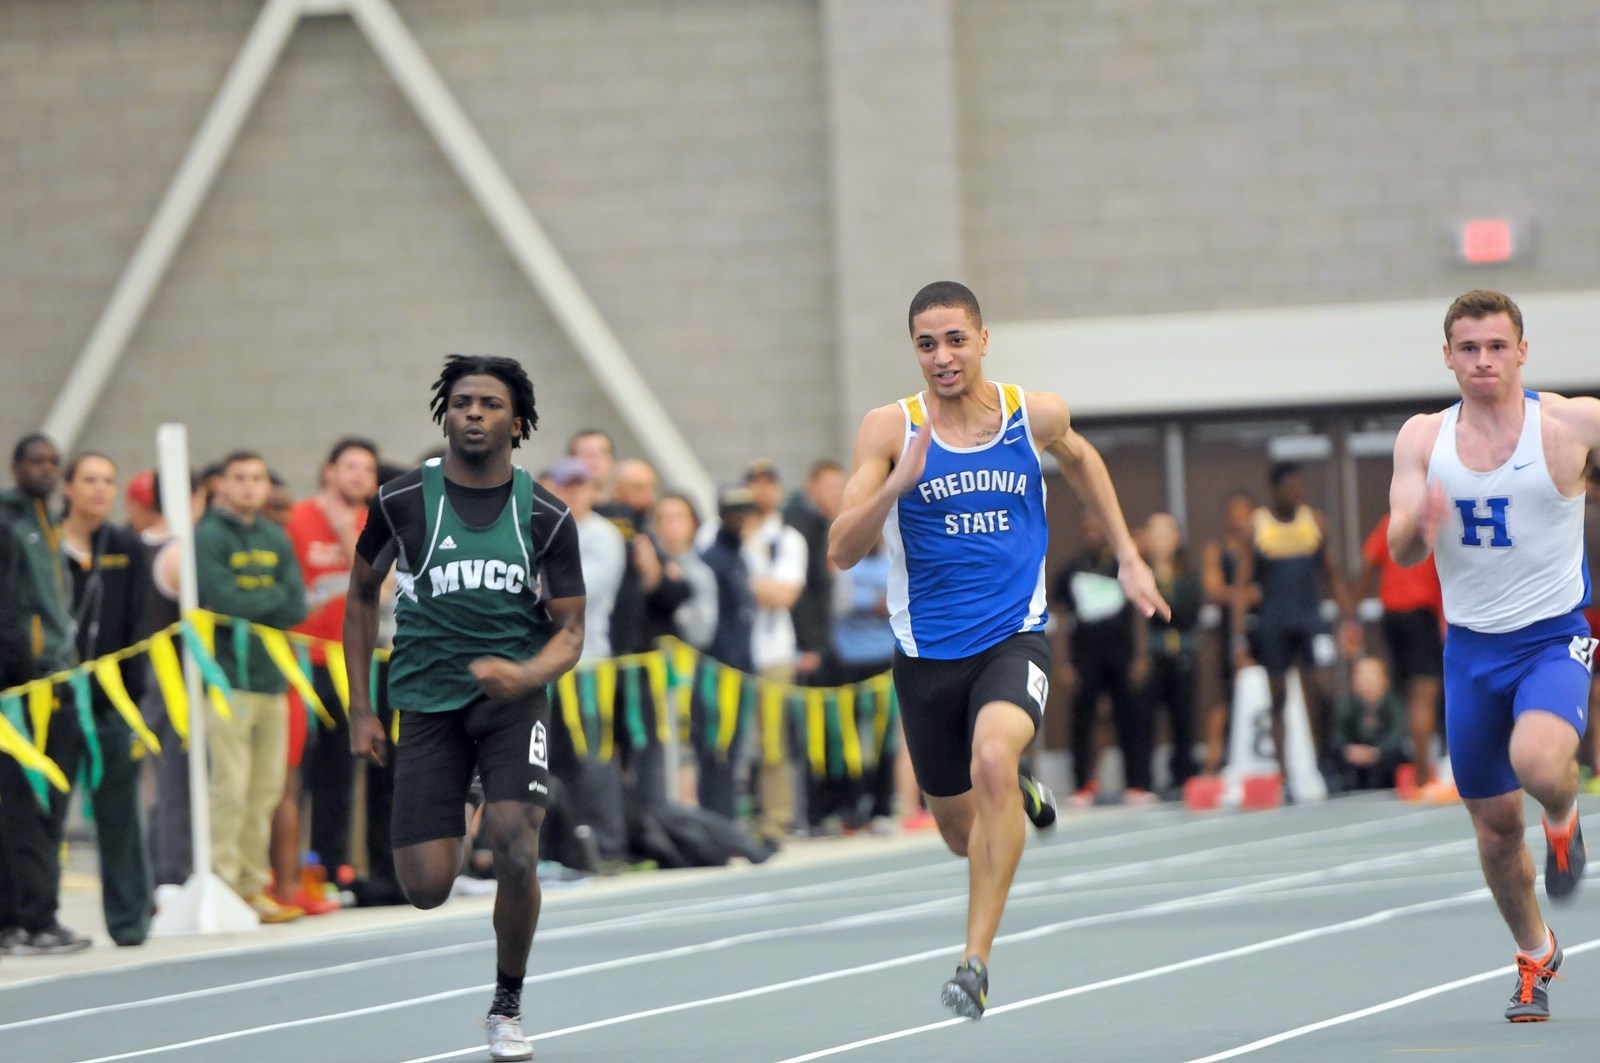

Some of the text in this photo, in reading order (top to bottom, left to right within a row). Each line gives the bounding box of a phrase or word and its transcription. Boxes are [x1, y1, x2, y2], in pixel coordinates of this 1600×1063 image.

[918, 469, 1028, 504] FREDONIA
[945, 509, 1010, 535] STATE
[1454, 496, 1514, 548] H
[429, 559, 525, 598] MVCC
[533, 724, 547, 762] 5
